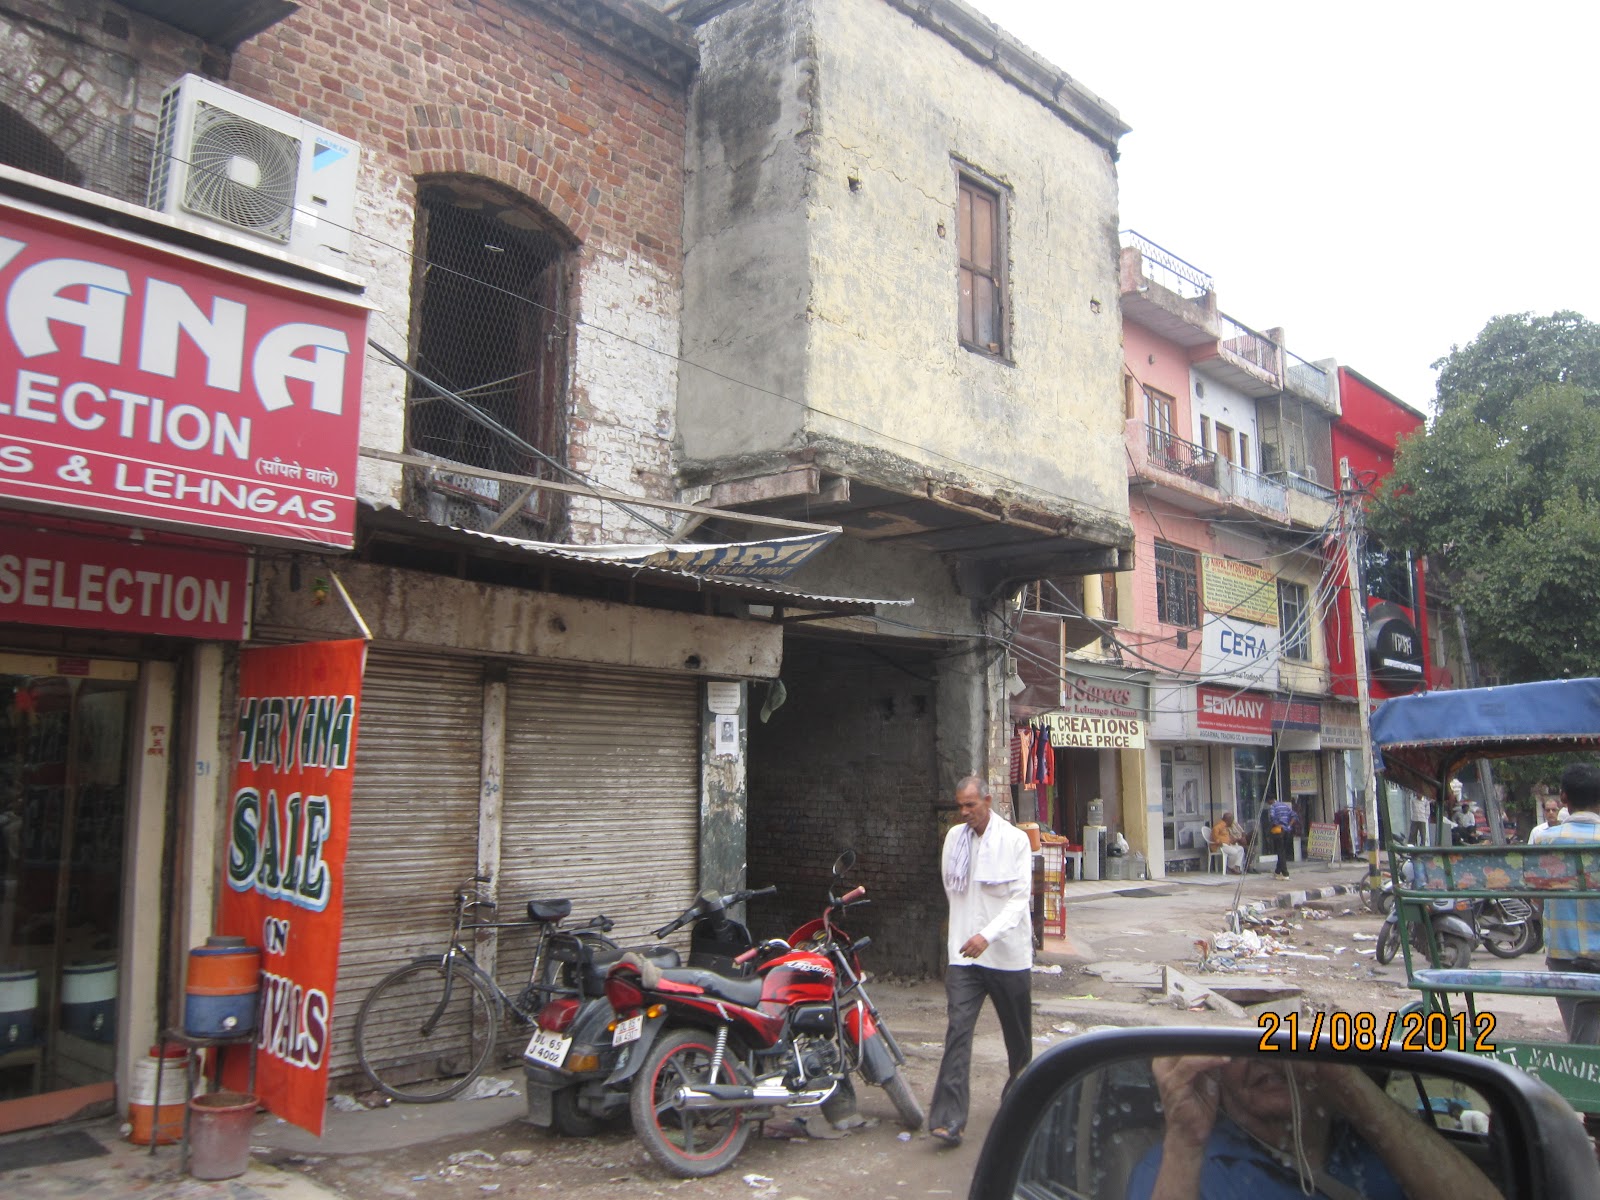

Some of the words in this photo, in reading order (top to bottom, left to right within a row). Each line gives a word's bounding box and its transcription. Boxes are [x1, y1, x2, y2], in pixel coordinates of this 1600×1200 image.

[315, 136, 349, 154] DAIKIN
[0, 369, 251, 460] ECTION
[57, 455, 93, 485] &
[115, 462, 337, 523] LEHNGAS
[0, 554, 230, 625] SELECTION
[1221, 630, 1267, 660] CERA
[1074, 677, 1130, 705] Sarees
[1203, 694, 1264, 719] SOMANY
[237, 695, 355, 777] HARYANA
[1058, 716, 1139, 735] CREATIONS
[1096, 735, 1130, 748] PRICE
[227, 787, 331, 912] SALE
[264, 915, 290, 956] IN
[534, 1033, 546, 1046] DL
[537, 1049, 559, 1063] 4002
